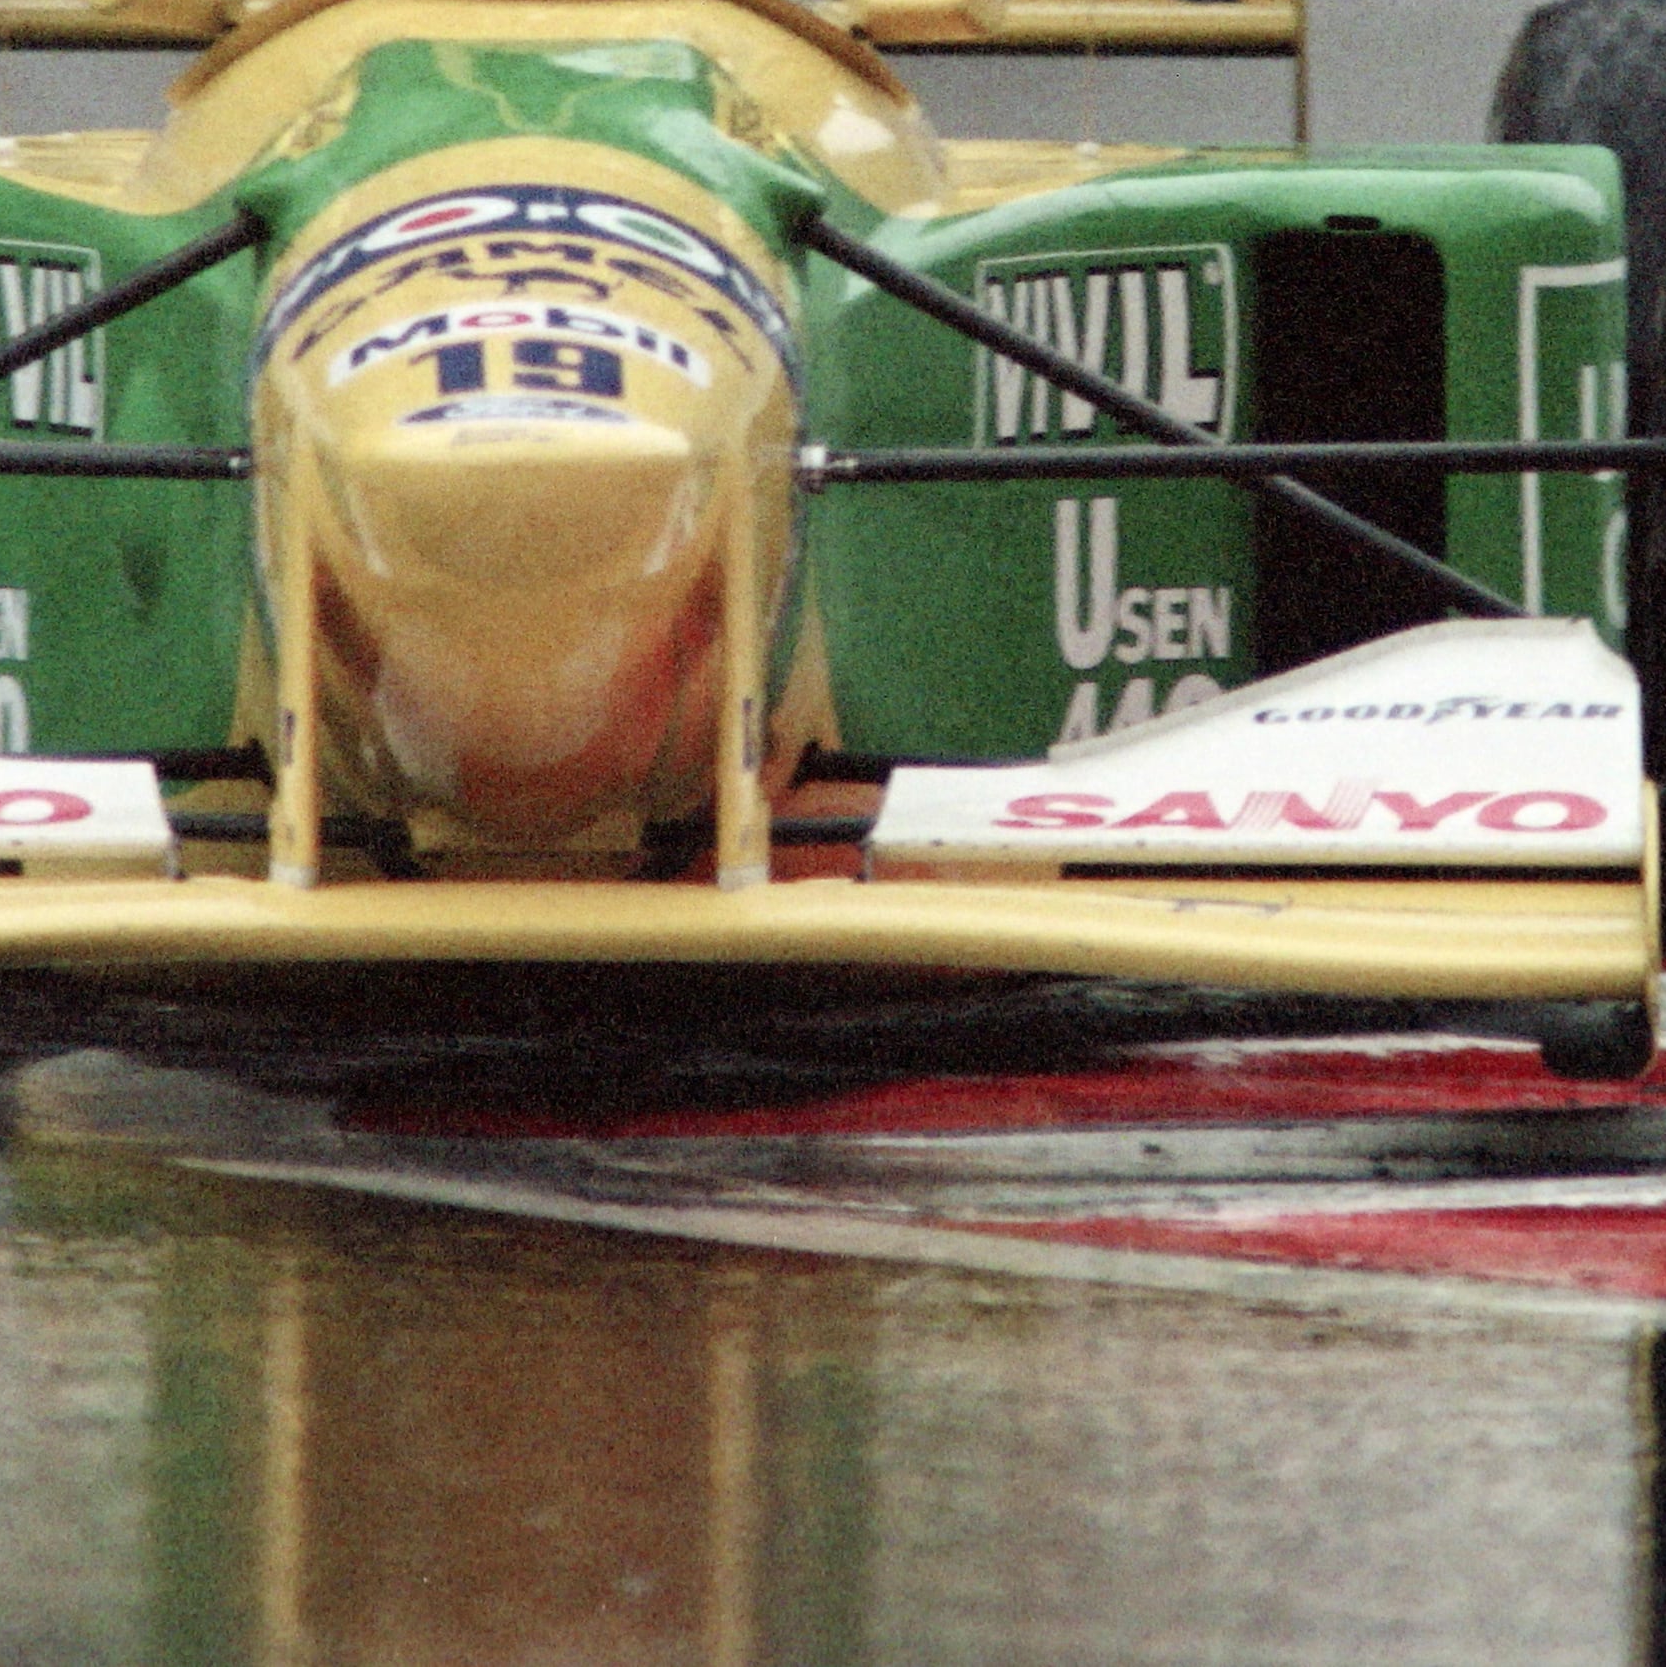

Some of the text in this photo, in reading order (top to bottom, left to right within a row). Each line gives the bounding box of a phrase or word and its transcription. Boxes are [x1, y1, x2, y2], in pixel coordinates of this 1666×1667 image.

[291, 240, 754, 372] CAMEL
[349, 307, 690, 369] Mobil
[408, 339, 624, 398] 19
[1254, 696, 1624, 725] GOODYEAR
[991, 782, 1610, 833] SANYO
